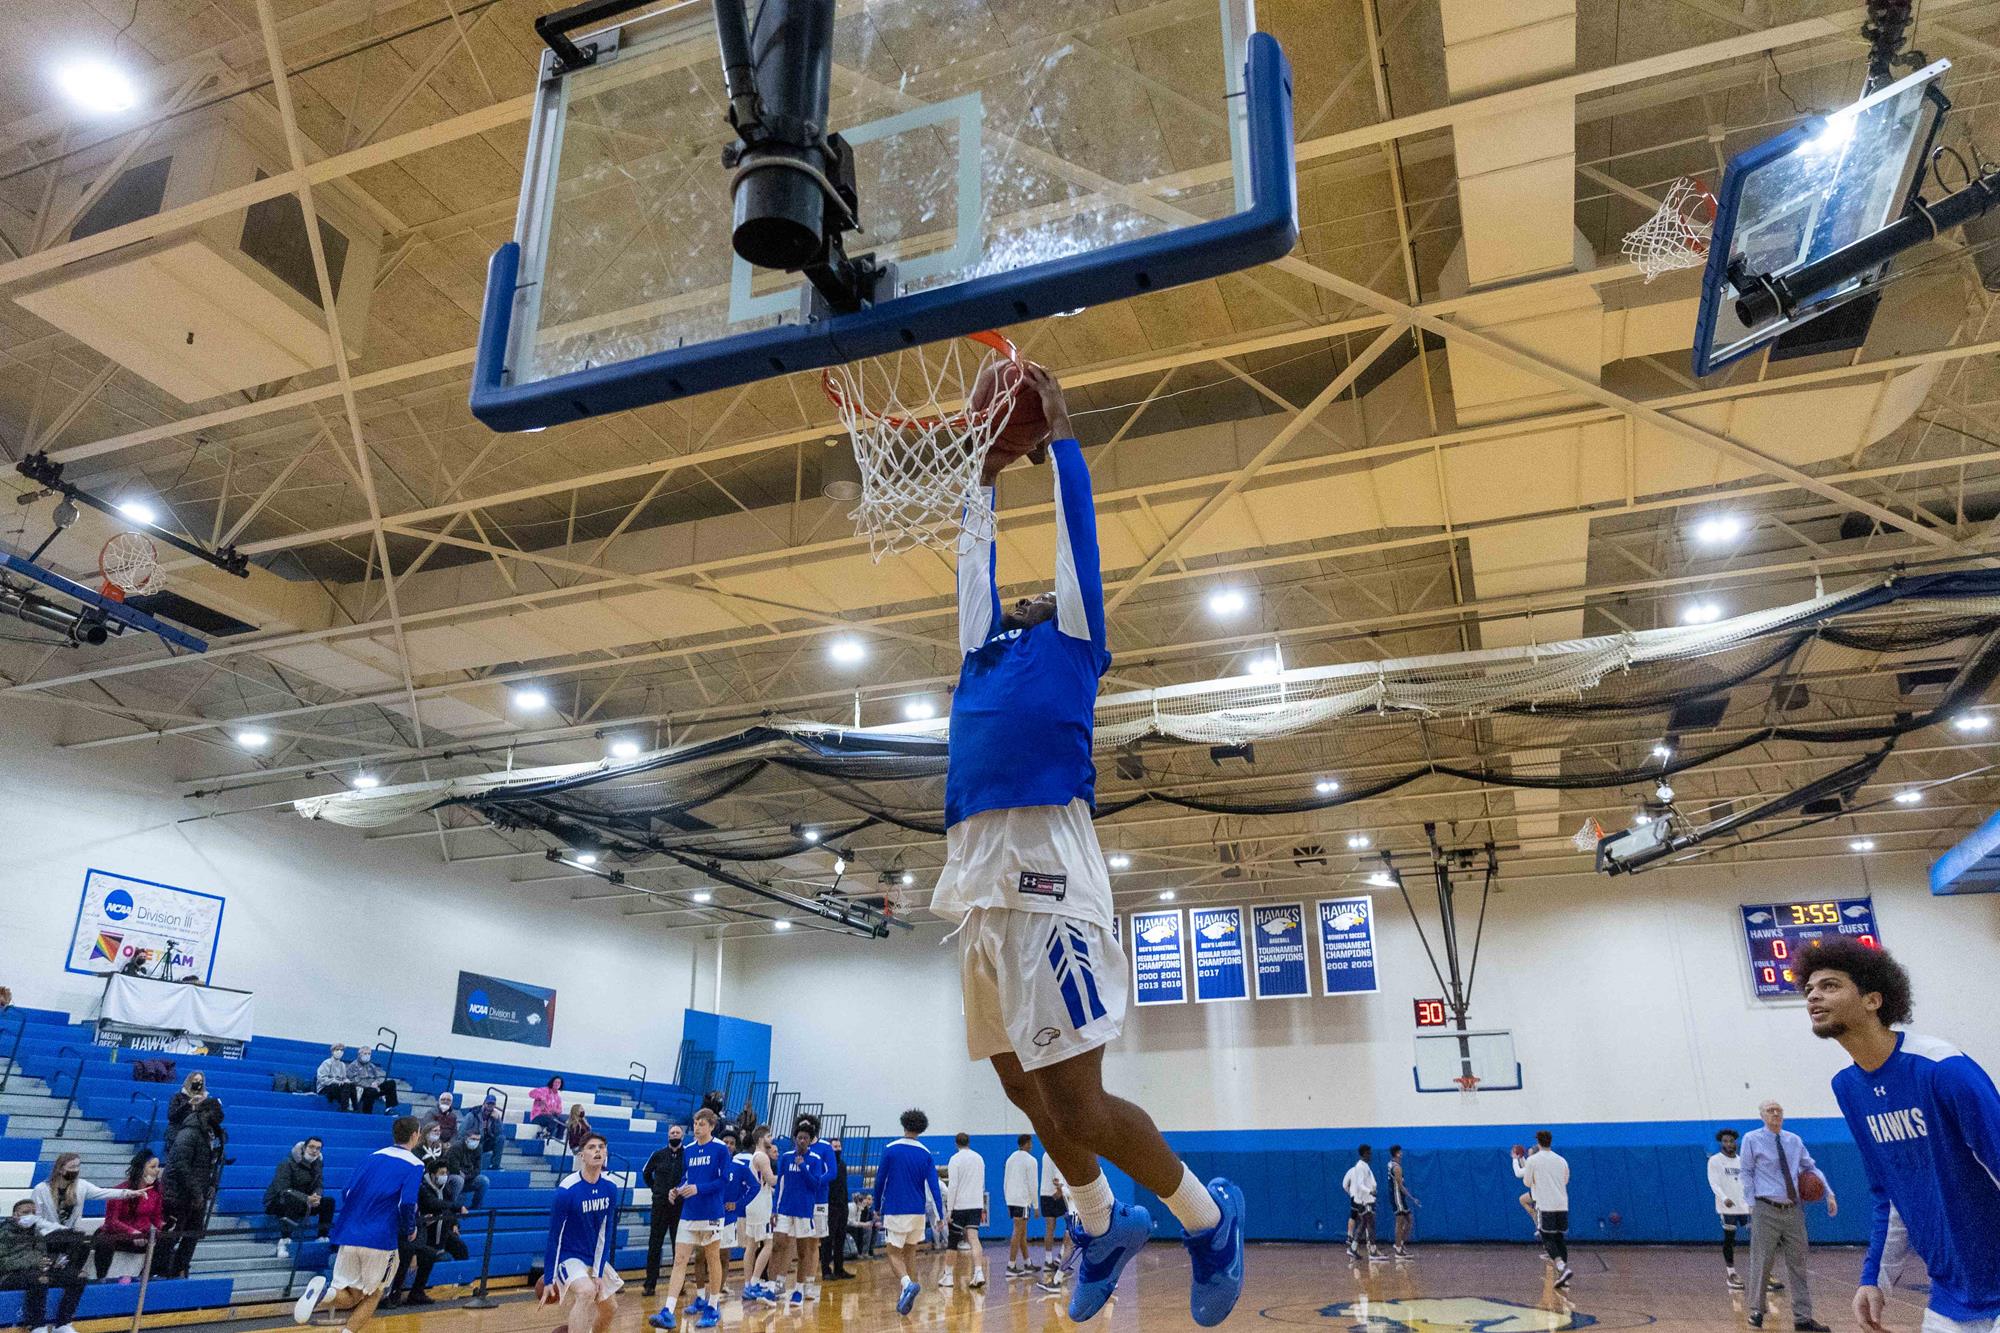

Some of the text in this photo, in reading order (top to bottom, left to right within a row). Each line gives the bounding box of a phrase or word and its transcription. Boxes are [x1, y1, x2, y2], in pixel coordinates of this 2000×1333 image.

[106, 902, 132, 914] NCAA
[137, 906, 181, 927] Division
[1256, 908, 1299, 925] HAWKS
[1322, 903, 1368, 921] HAWKS
[1791, 903, 1840, 925] 3:55
[1136, 916, 1177, 933] HAWKS
[1195, 912, 1238, 930] HAWKS
[1750, 928, 1784, 940] HAWKS
[1838, 923, 1870, 934] GUEST
[1258, 945, 1302, 955] TOURNAMENT
[1325, 940, 1370, 950] TOURNAMENT
[1773, 940, 1788, 959] 0
[1259, 953, 1303, 963] CHAMPIONS
[1326, 949, 1372, 960] CHAMPIONS
[1138, 960, 1180, 971] CHAMPIONS
[1198, 956, 1241, 967] CHAMPIONS
[1327, 960, 1373, 970] 2002 2003
[1199, 969, 1219, 977] 2017
[1259, 966, 1280, 974] 2003
[1764, 968, 1776, 982] 0
[1138, 971, 1181, 981] 2000 2001
[1139, 980, 1181, 990] 2013 2016
[469, 1003, 488, 1015] NCAA
[489, 1006, 511, 1018] Division
[1419, 1003, 1443, 1023] 30
[100, 1031, 123, 1041] MEDIA
[1866, 1107, 1929, 1143] HAWKS
[689, 1155, 711, 1166] HAWKS
[582, 1196, 610, 1214] HAWKS
